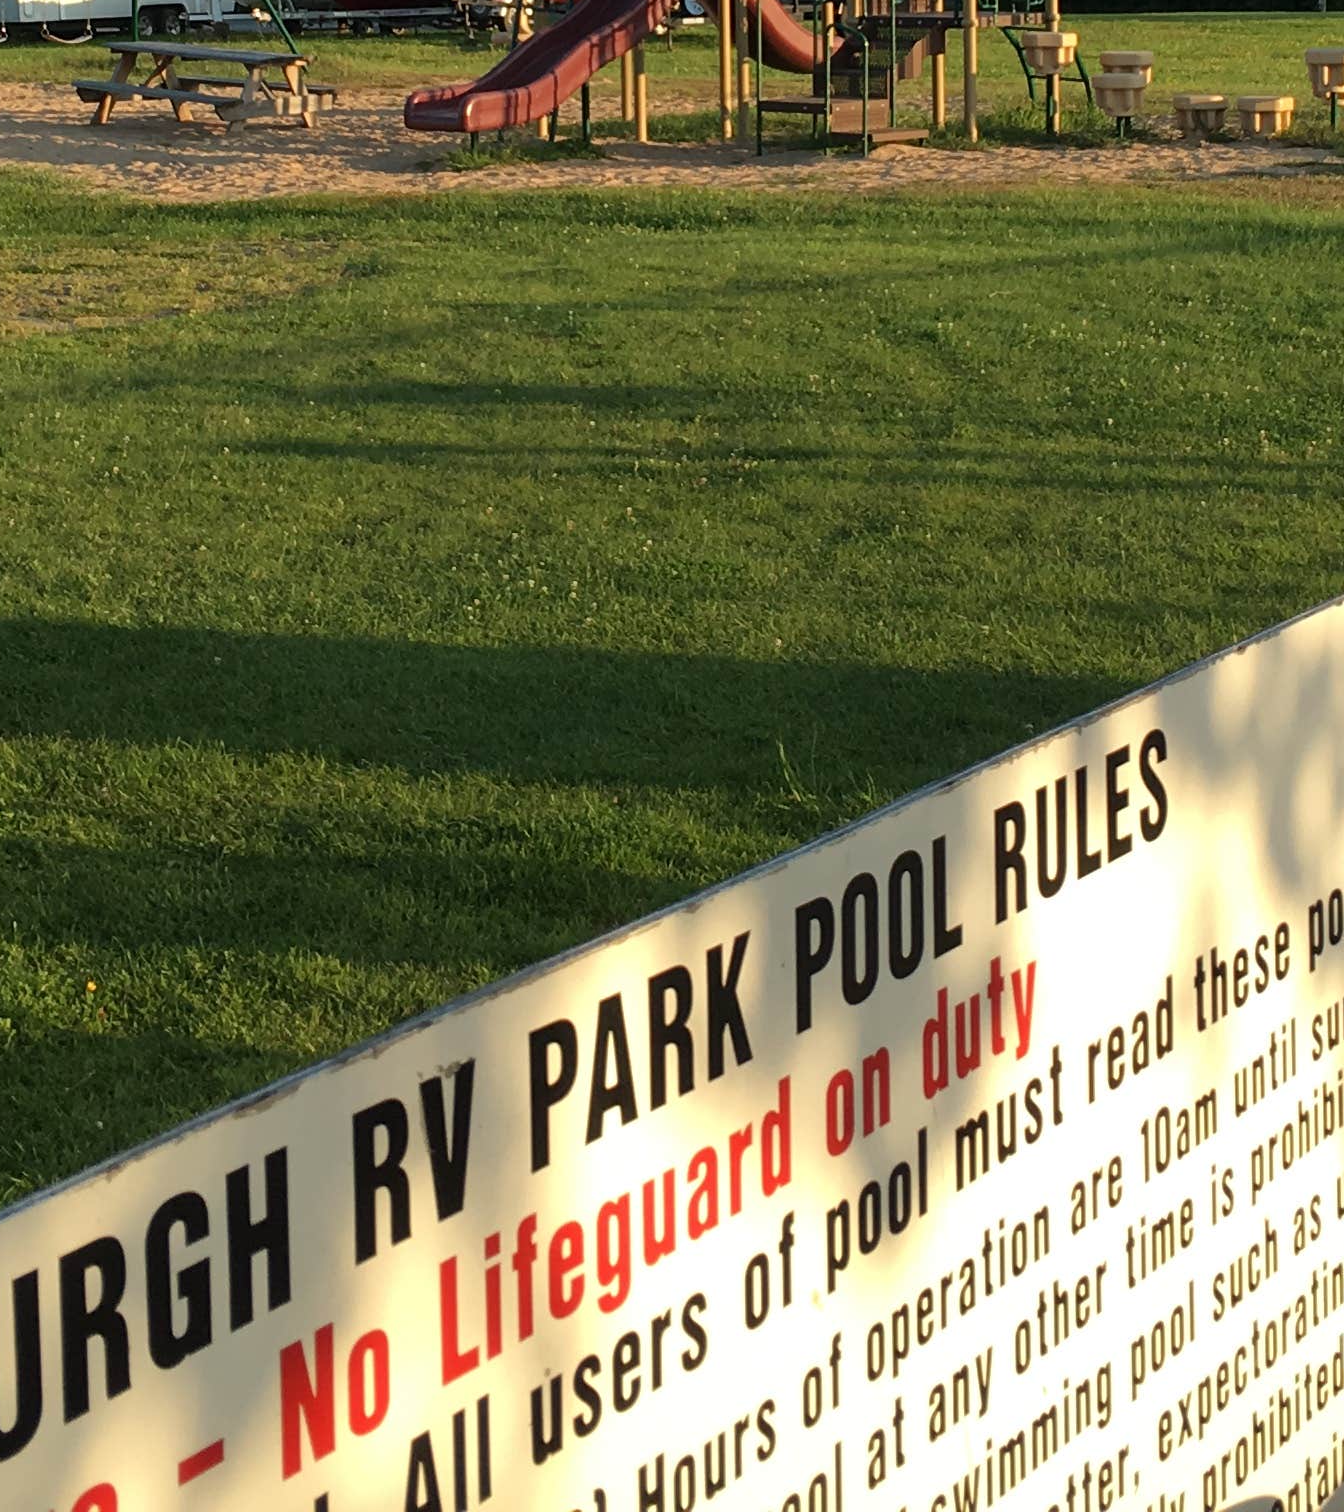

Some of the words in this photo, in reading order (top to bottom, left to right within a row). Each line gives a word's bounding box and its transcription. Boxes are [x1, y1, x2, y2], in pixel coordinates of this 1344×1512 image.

[279, 1322, 390, 1482] No
[439, 1075, 792, 1387] Lifeguard
[825, 1045, 891, 1156] on
[922, 956, 1036, 1100] duty
[352, 1057, 476, 1266] RV
[528, 929, 754, 1174] PARK
[795, 835, 963, 1035] POOL
[993, 728, 1167, 925] RULES
[404, 1394, 492, 1512] All
[530, 1293, 707, 1466] users
[744, 1210, 794, 1330] of
[827, 1127, 928, 1295] pool
[955, 1045, 1063, 1192] must
[1087, 975, 1175, 1104] read
[1194, 921, 1290, 1033] these
[638, 1399, 777, 1512] Hours
[802, 1331, 842, 1429] of
[866, 1205, 1051, 1383] operation
[1069, 1155, 1123, 1236] are
[1141, 1087, 1219, 1183] 10am
[1234, 1017, 1296, 1118] until
[868, 1396, 905, 1490] at
[928, 1346, 993, 1442] any
[1014, 1262, 1107, 1375] other
[1126, 1197, 1194, 1289] time
[1211, 1164, 1234, 1226] is
[1048, 1445, 1139, 1512] tter,
[1130, 1280, 1196, 1401] pool
[1212, 1218, 1279, 1322] such
[1293, 1194, 1322, 1256] as
